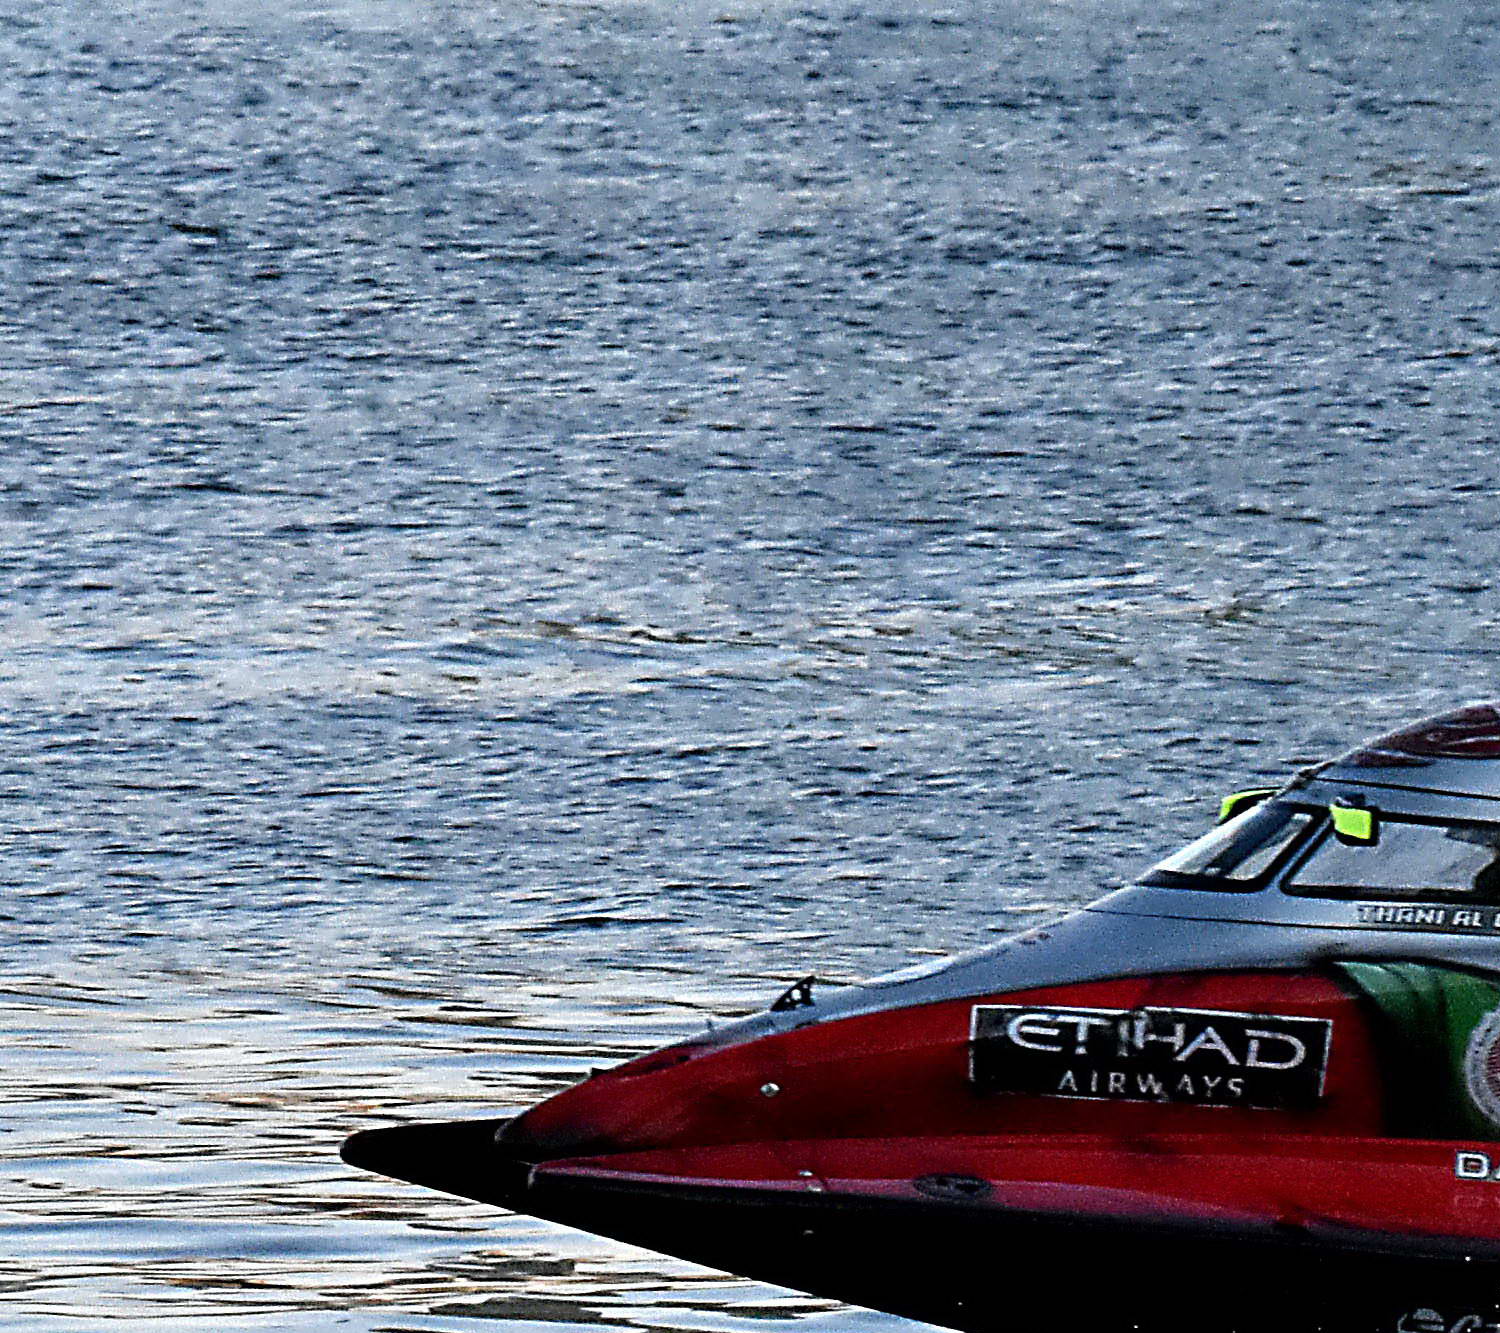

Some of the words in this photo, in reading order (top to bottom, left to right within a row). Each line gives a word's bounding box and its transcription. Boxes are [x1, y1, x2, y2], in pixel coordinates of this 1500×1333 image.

[1357, 905, 1446, 925] THANI
[1452, 910, 1482, 928] AL
[1005, 1010, 1307, 1070] ETIHAD
[1057, 1069, 1245, 1097] AIRWAYS
